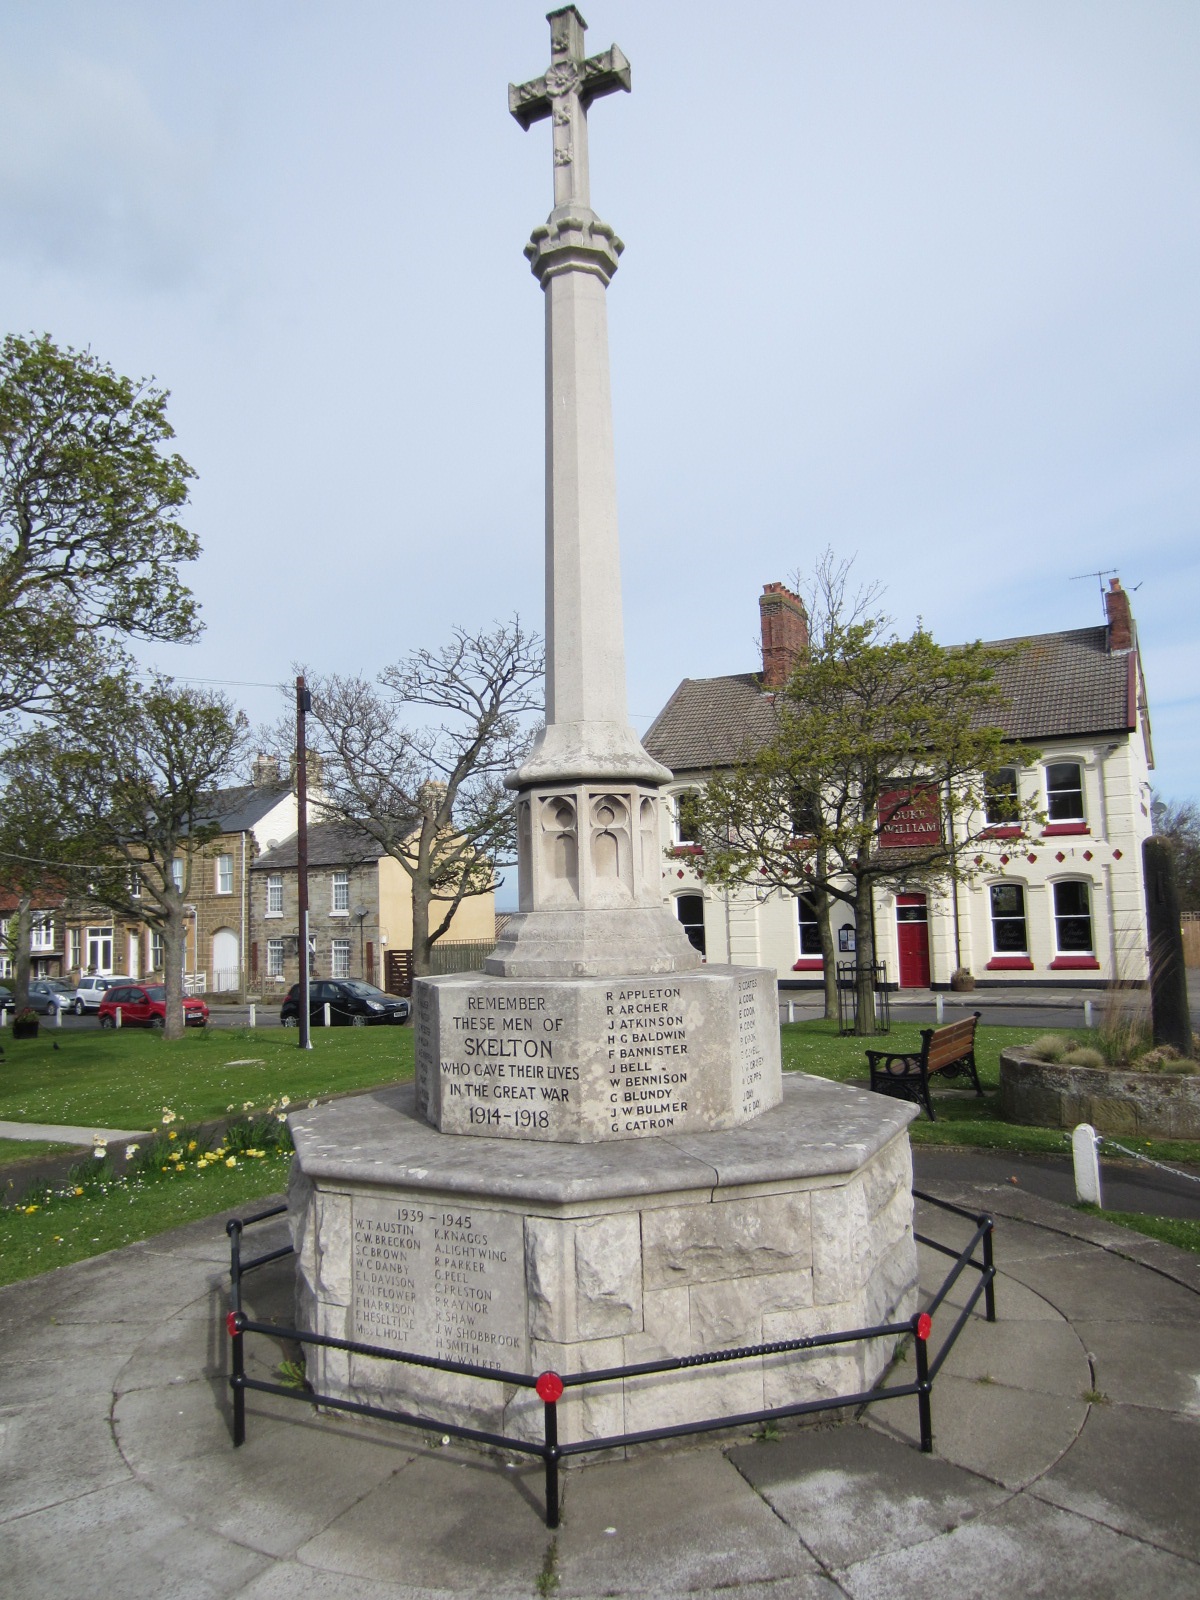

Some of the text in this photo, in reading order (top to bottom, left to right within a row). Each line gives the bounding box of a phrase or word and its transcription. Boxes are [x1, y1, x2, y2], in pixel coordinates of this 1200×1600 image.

[893, 810, 926, 820] DUKE
[884, 822, 936, 834] WILLIAM
[742, 978, 757, 990] COATES
[606, 988, 680, 1000] R APPLETON
[743, 994, 754, 1004] COOK
[468, 997, 545, 1010] REMEMBER
[606, 1002, 668, 1015] R ARCHER
[744, 1006, 756, 1018] COOK
[452, 1016, 563, 1032] THESE MEN OF
[608, 1016, 683, 1030] J ATKINSON
[608, 1030, 686, 1044] H G BALDWIN
[464, 1037, 552, 1059] SKELTON
[608, 1044, 688, 1059] F BANNISTER
[440, 1062, 470, 1076] WHO
[474, 1063, 506, 1077] GAVE
[508, 1064, 544, 1078] THEIR
[546, 1066, 580, 1080] LIVES
[608, 1062, 652, 1074] J BELL
[610, 1072, 687, 1088] W BENNISON
[450, 1083, 570, 1102] IN THE GREAT WAR
[610, 1088, 672, 1102] G BLUNDY
[610, 1102, 688, 1118] J W BULMER
[612, 1118, 674, 1132] G CATRON
[398, 1208, 424, 1222] 1939
[442, 1214, 472, 1229] 1945
[376, 1222, 414, 1236] AUSTIN
[375, 1234, 421, 1250] BRECKON
[370, 1247, 408, 1262] BROWN
[376, 1260, 410, 1275] DANBY
[444, 1258, 486, 1274] PARKER
[372, 1272, 415, 1289] DAVISON
[445, 1271, 468, 1284] PEEL
[378, 1286, 416, 1303] FLOWER
[364, 1298, 415, 1316] HARRISON
[444, 1298, 489, 1314] RAYNOR
[364, 1311, 415, 1330] HESELTINE
[446, 1312, 476, 1326] SHAW
[384, 1328, 409, 1342] HOLT
[456, 1326, 520, 1348] SHOBBROOK
[446, 1338, 479, 1354] SMITH
